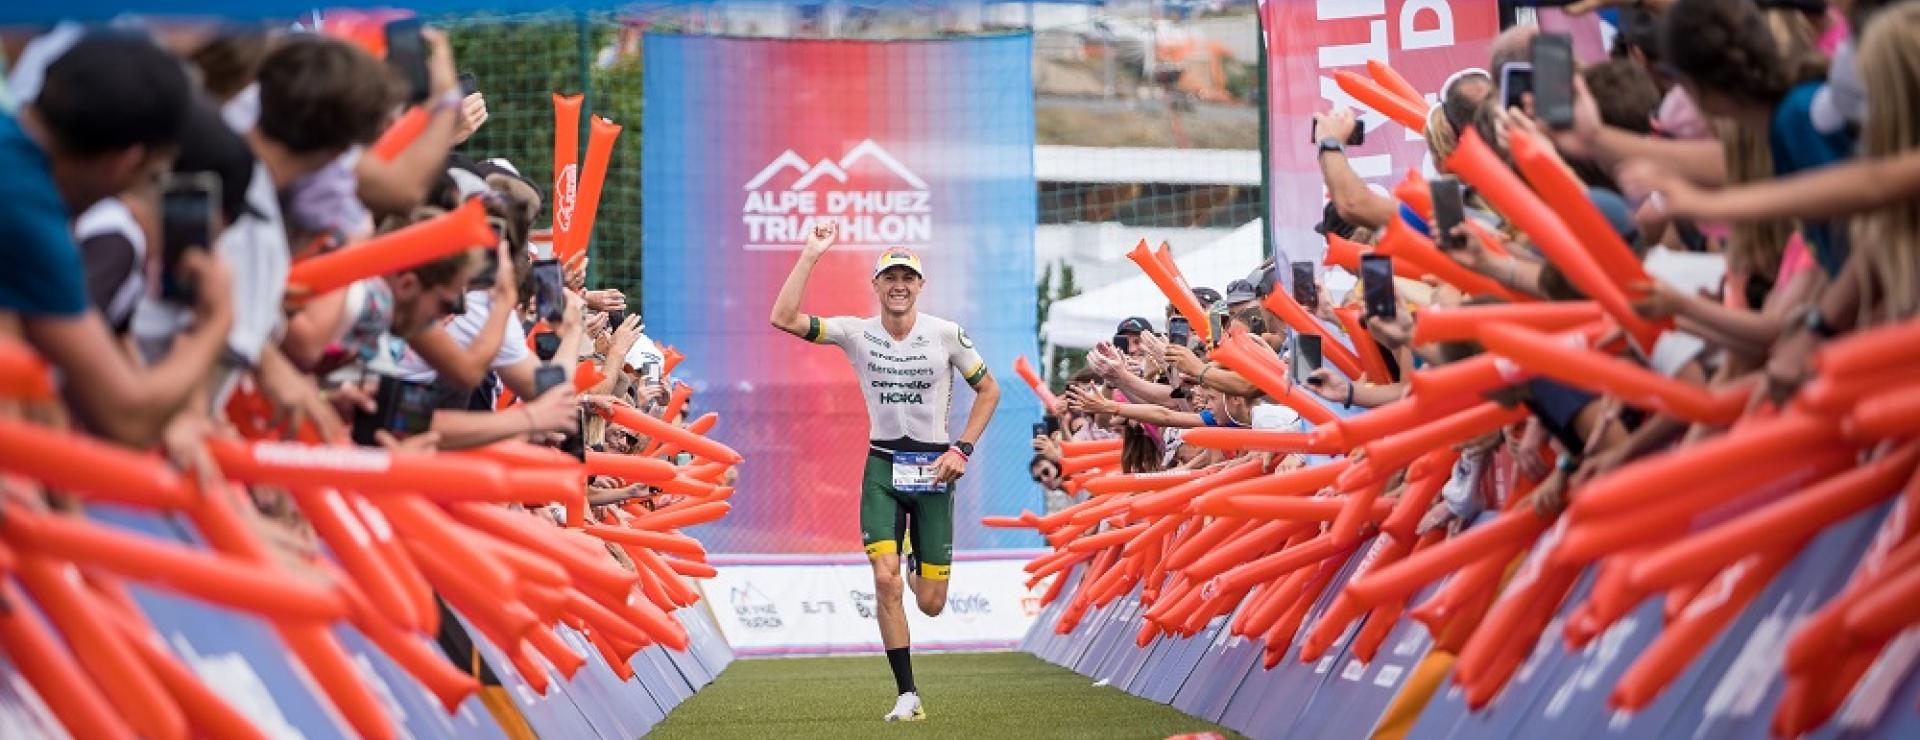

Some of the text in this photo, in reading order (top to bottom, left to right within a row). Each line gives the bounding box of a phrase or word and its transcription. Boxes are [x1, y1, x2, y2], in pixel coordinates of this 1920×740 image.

[743, 191, 931, 213] ALPE D'HUEZ
[743, 214, 932, 242] TRIAHLON
[880, 392, 922, 404] HOKA
